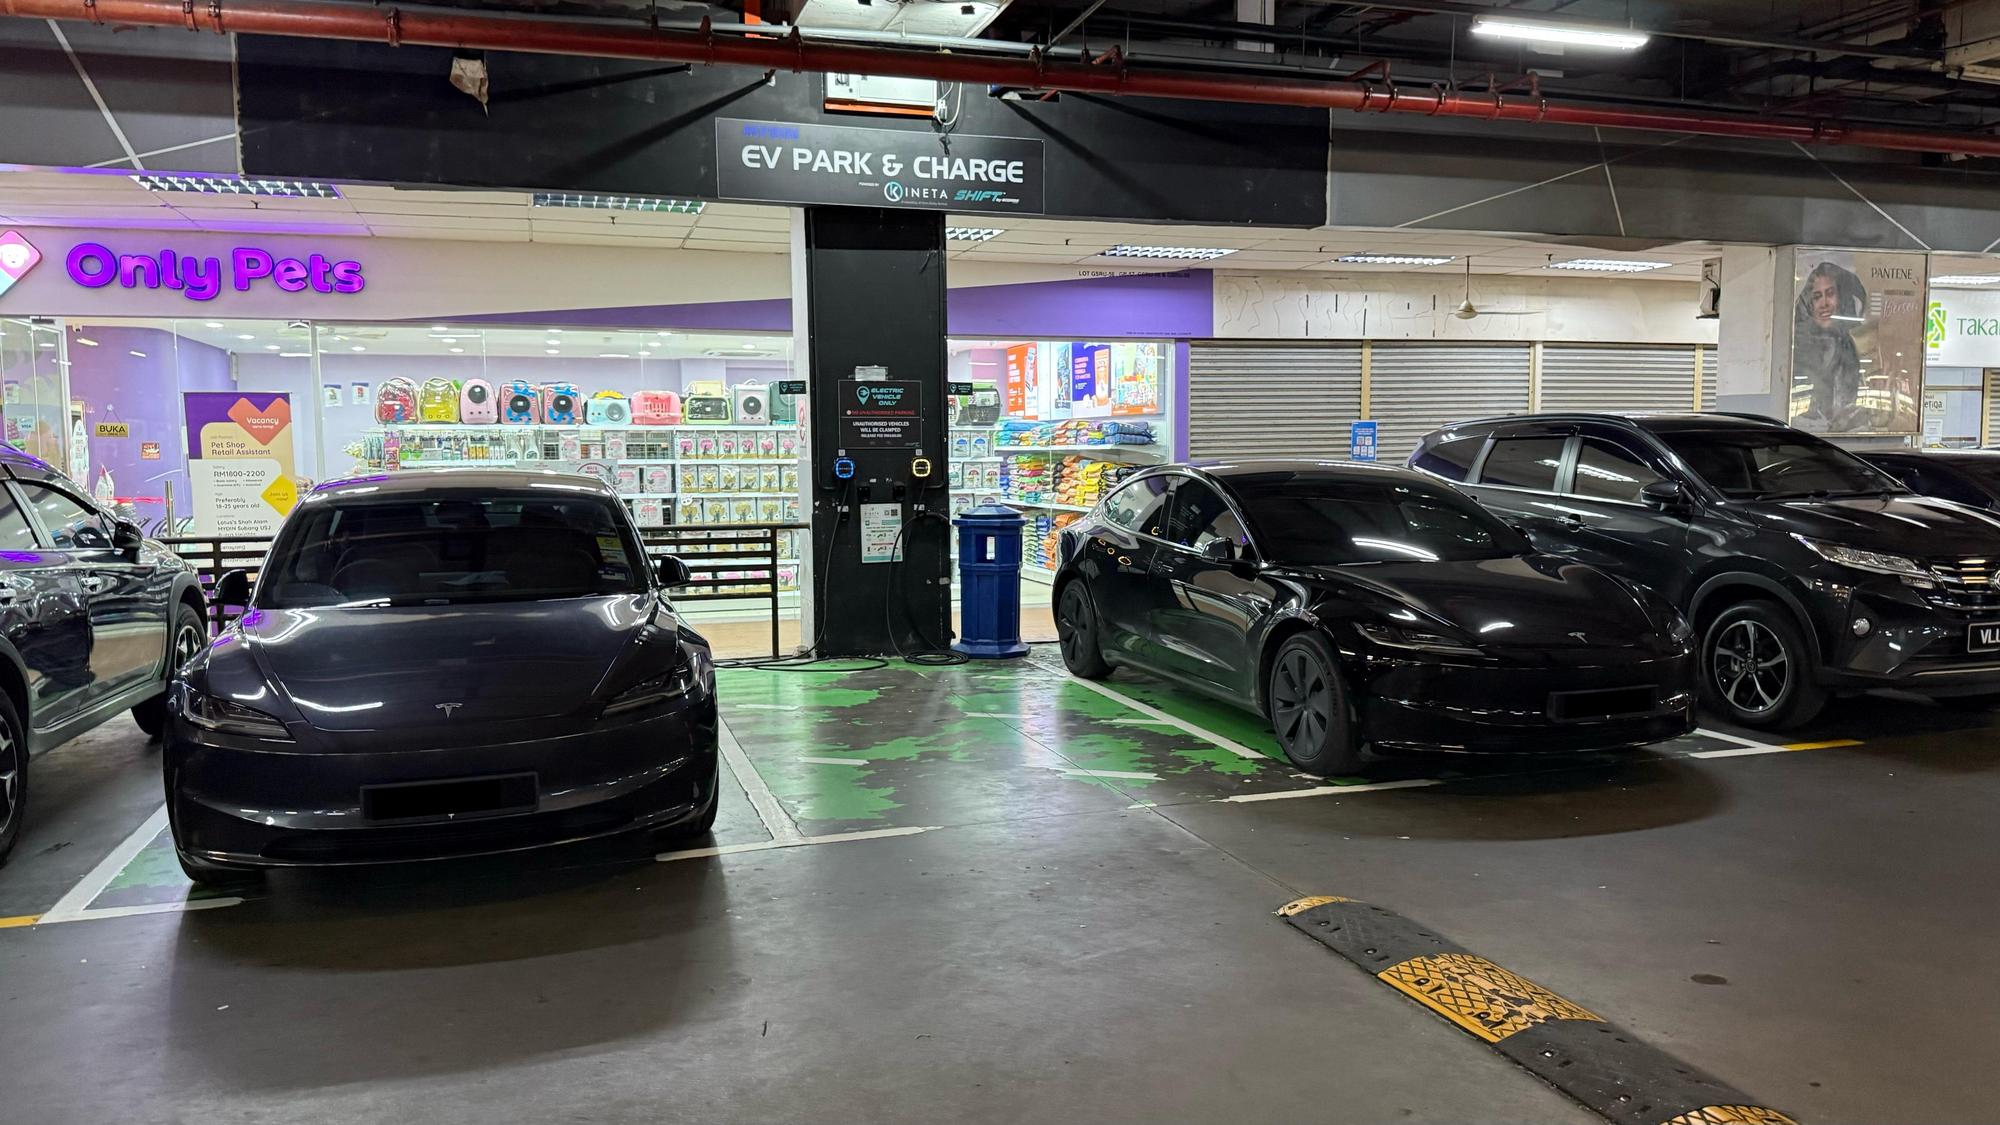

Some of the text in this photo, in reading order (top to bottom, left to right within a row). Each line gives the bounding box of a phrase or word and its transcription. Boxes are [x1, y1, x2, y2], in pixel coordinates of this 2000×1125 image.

[741, 145, 1024, 183] EV PARK & CHARGE
[953, 189, 1002, 202] SHIFT
[66, 242, 365, 301] Only Pets
[1871, 267, 1913, 280] PANTENE
[246, 416, 279, 425] Vacancy
[99, 425, 126, 433] BUKA
[226, 441, 246, 449] Shop
